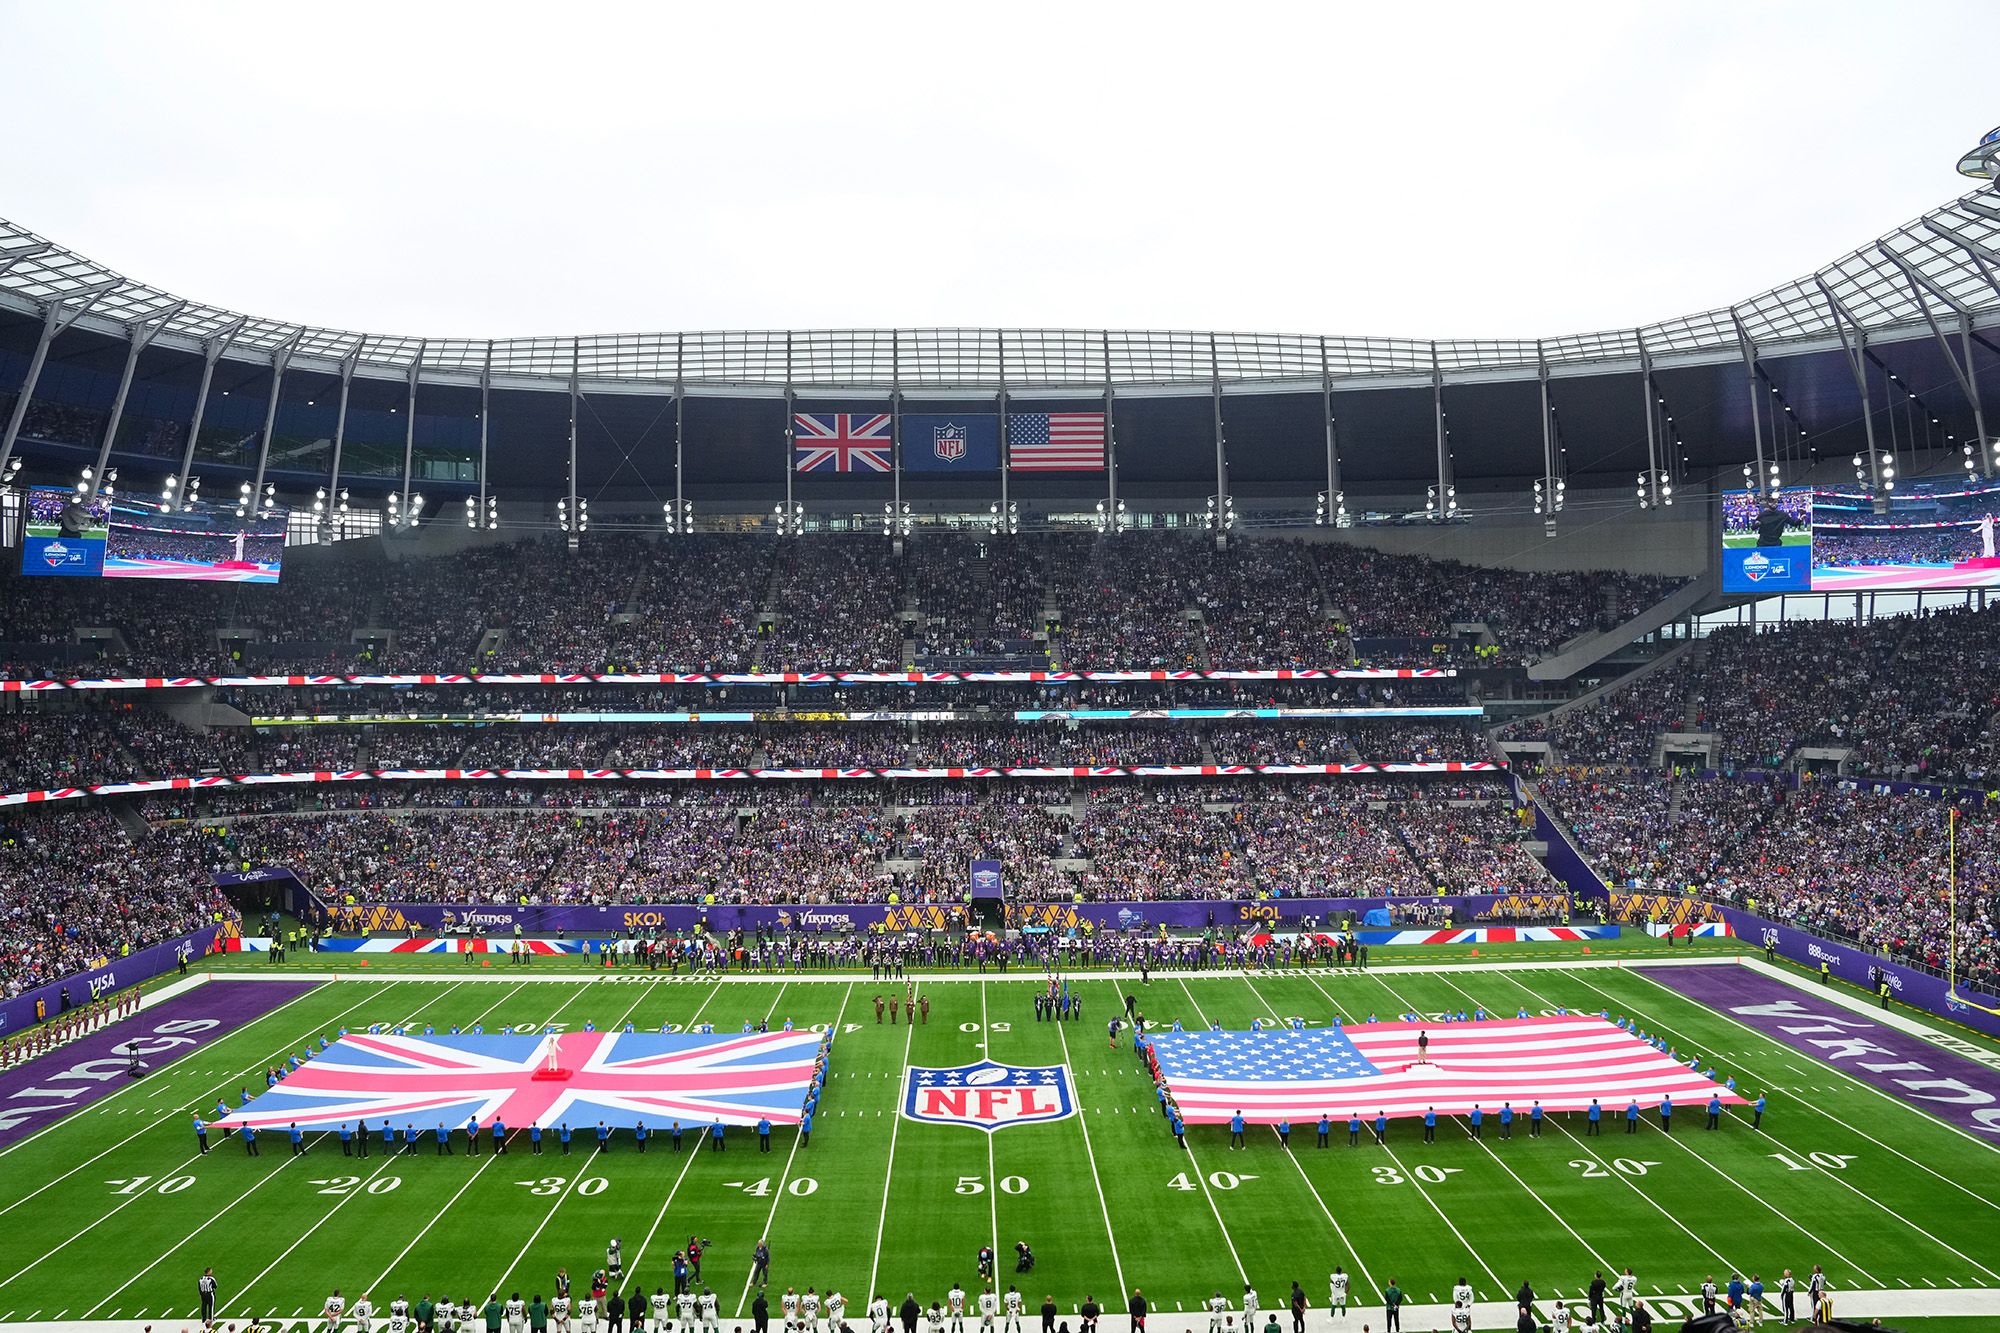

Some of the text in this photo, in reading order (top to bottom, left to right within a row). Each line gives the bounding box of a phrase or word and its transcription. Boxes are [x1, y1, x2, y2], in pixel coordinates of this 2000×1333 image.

[938, 441, 963, 457] NFL
[1240, 905, 1282, 919] SKOL
[1808, 943, 1840, 966] 888sport
[87, 972, 115, 992] VISA
[1921, 1034, 1983, 1054] END
[922, 1088, 1056, 1120] NFL
[1569, 1159, 1647, 1177] 20
[1769, 1152, 1847, 1170] 10
[1168, 1172, 1239, 1190] 40
[1372, 1166, 1446, 1184] 30
[111, 1176, 196, 1194] 10
[318, 1176, 401, 1194] 20
[531, 1177, 608, 1195] 30
[743, 1178, 818, 1196] 40
[955, 1176, 1029, 1194] 50
[1335, 1280, 1346, 1289] 97
[1627, 1282, 1634, 1290] 6
[328, 1304, 341, 1313] 42
[508, 1306, 521, 1315] 75
[784, 1302, 796, 1310] 84
[952, 1297, 961, 1307] 10
[1010, 1300, 1017, 1309] 5
[358, 1308, 366, 1317] 9
[581, 1307, 593, 1315] 76
[876, 1308, 884, 1317] 0
[391, 1321, 403, 1331] 22
